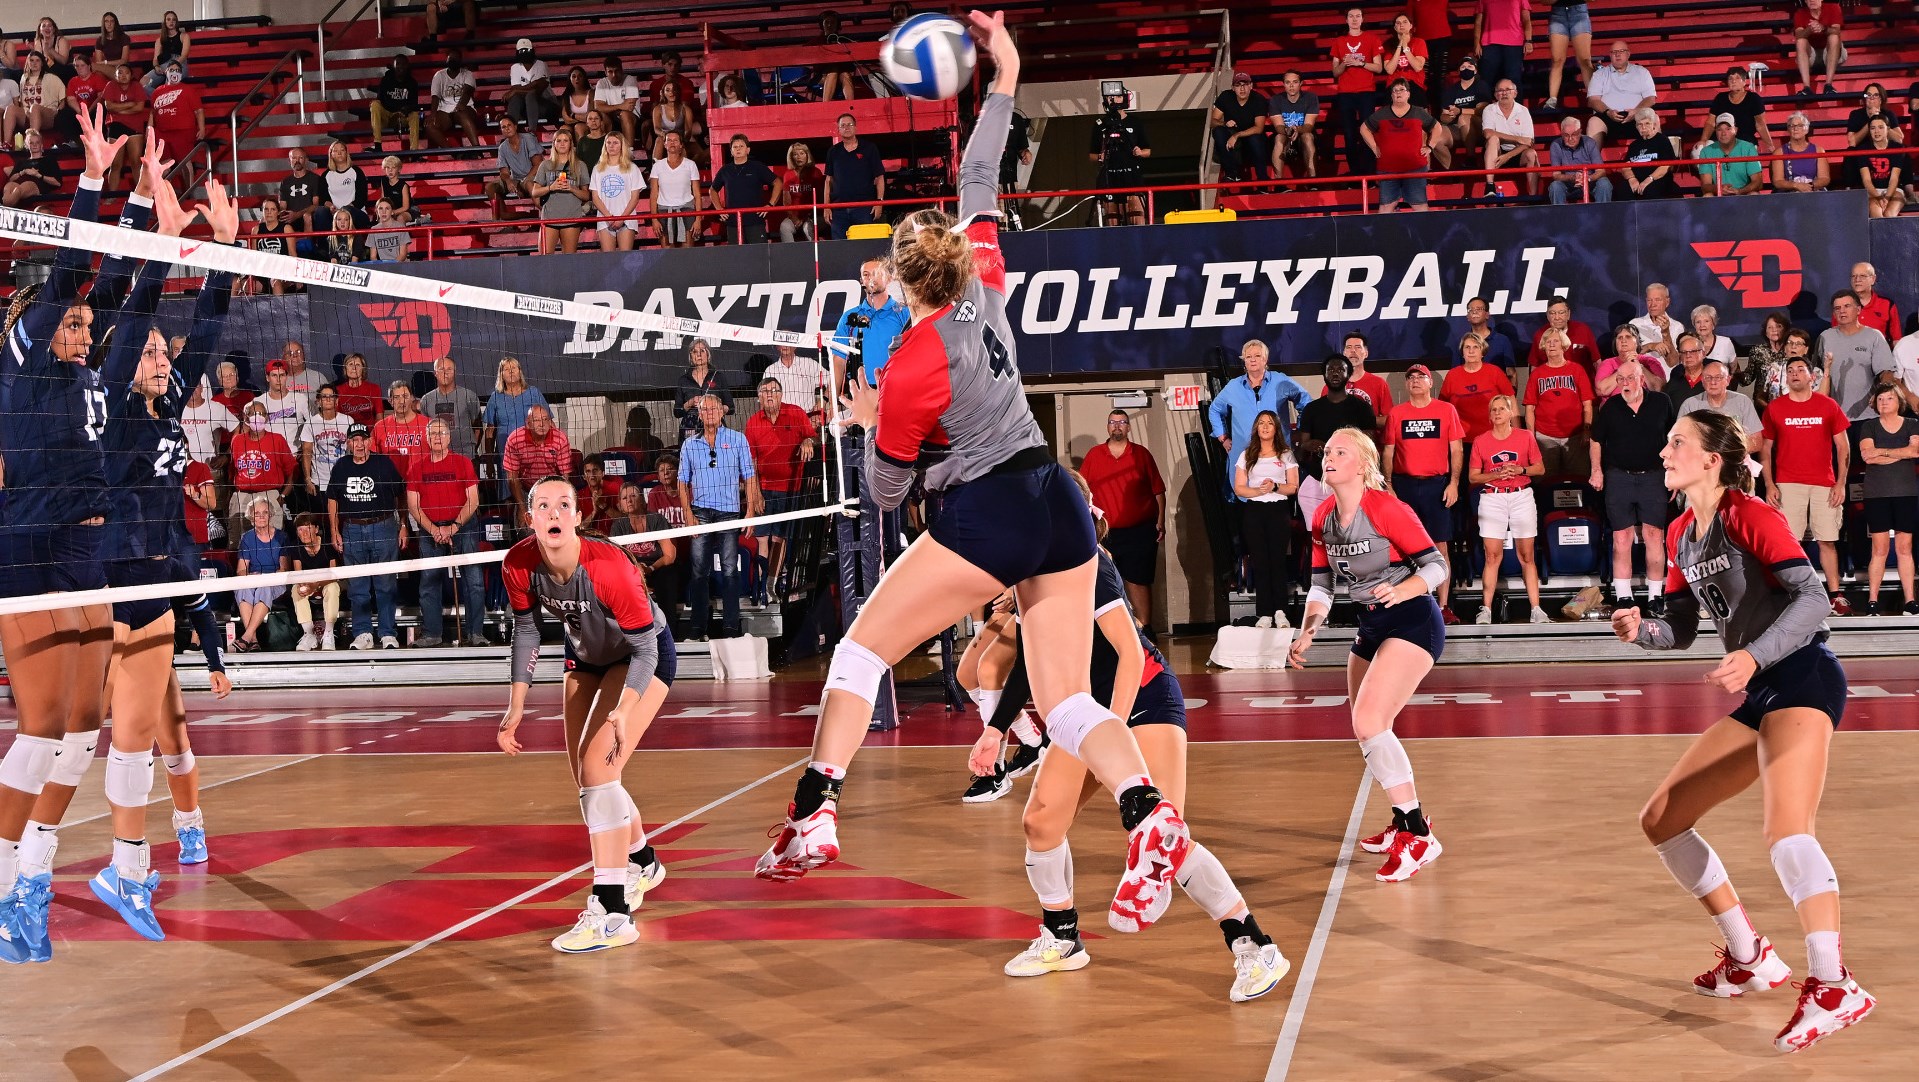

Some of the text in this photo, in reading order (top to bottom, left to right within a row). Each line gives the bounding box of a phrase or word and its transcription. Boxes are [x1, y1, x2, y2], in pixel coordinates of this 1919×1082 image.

[1454, 95, 1476, 105] AYTO
[17, 212, 66, 238] FLYERS
[295, 258, 370, 286] FLYER LEGACY
[563, 246, 1568, 354] DAYTO OLLEYBALL
[980, 319, 1015, 382] 4
[1537, 375, 1577, 394] DAYTON
[1174, 386, 1200, 407] EXIT
[1405, 425, 1436, 433] LEGACY
[1785, 417, 1823, 426] DAYTON
[384, 433, 422, 448] FLYERS
[237, 459, 271, 471] ELITE 8
[658, 506, 686, 524] AYT
[1336, 560, 1359, 583] 5
[1697, 582, 1732, 621] 18
